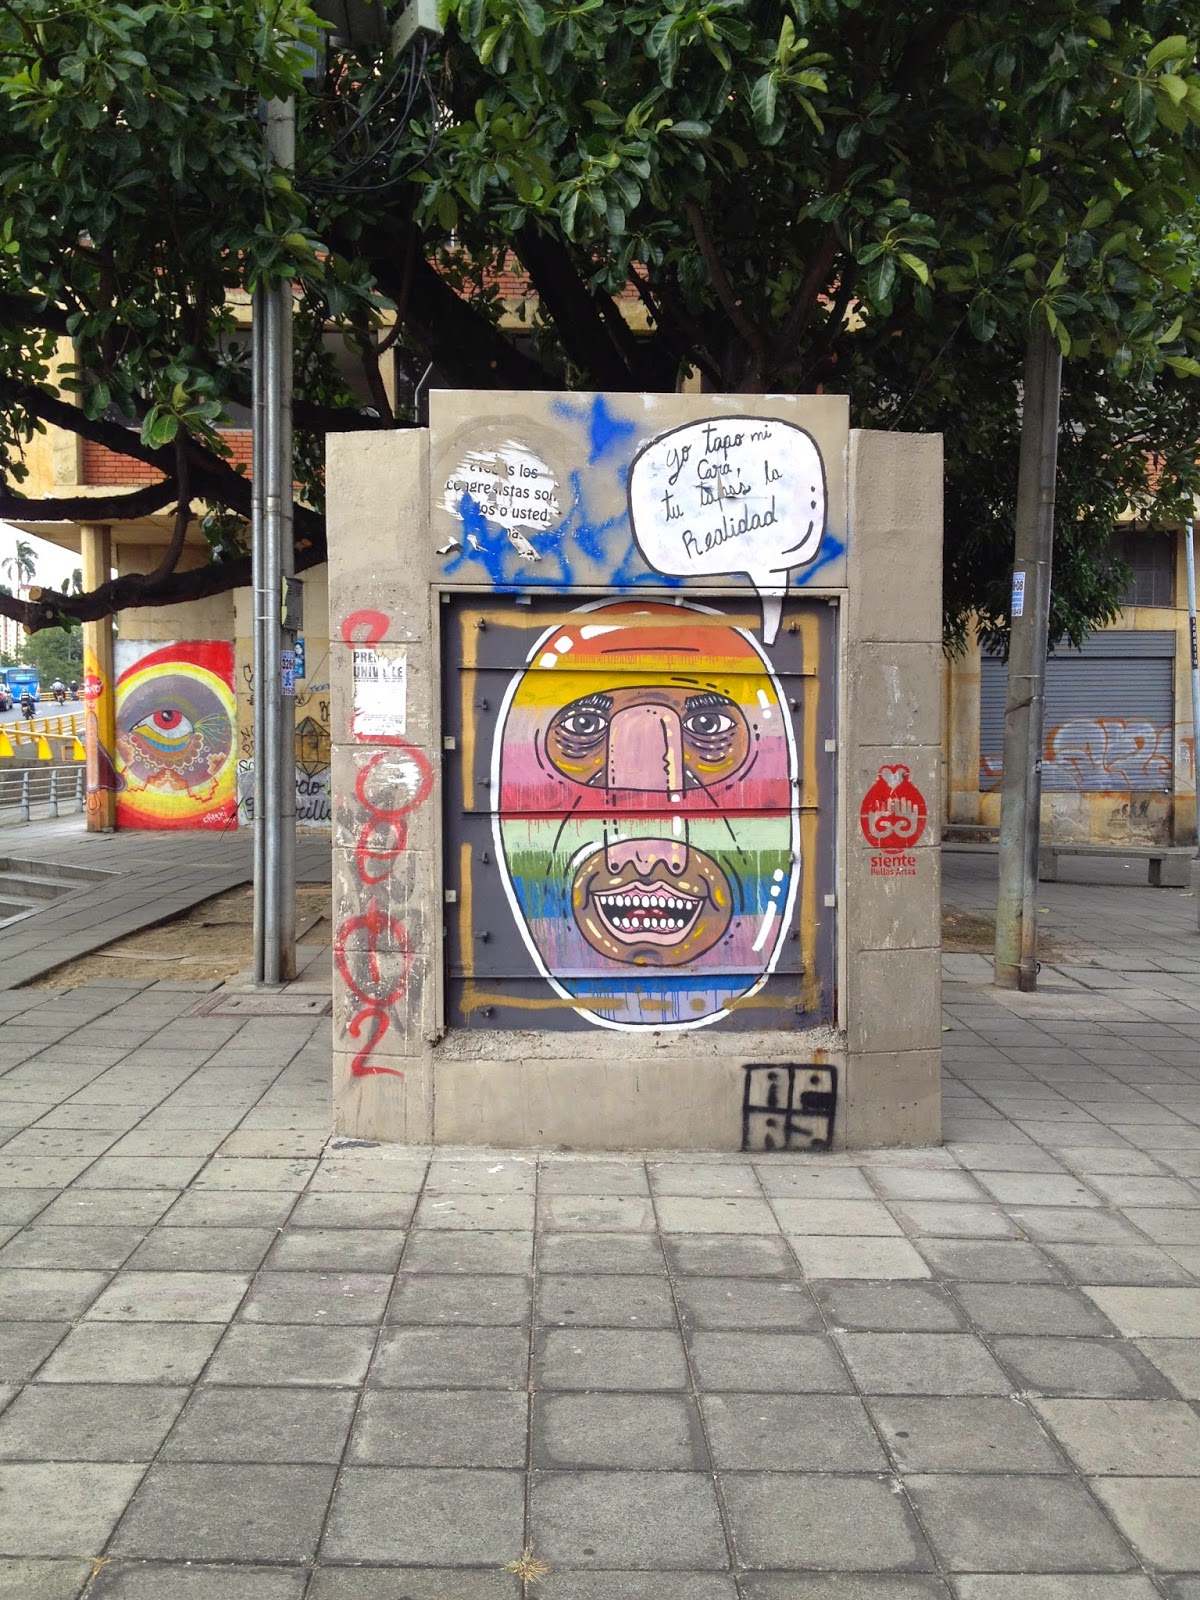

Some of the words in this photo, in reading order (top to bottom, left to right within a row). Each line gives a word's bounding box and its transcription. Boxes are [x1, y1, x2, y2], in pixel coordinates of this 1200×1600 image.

[702, 423, 745, 461] tapo
[751, 424, 772, 443] mi
[520, 464, 538, 479] los
[661, 490, 684, 521] tu
[764, 460, 783, 485] la
[499, 506, 508, 517] o
[512, 507, 548, 522] usted
[682, 495, 778, 559] Realidad
[870, 854, 916, 867] siente
